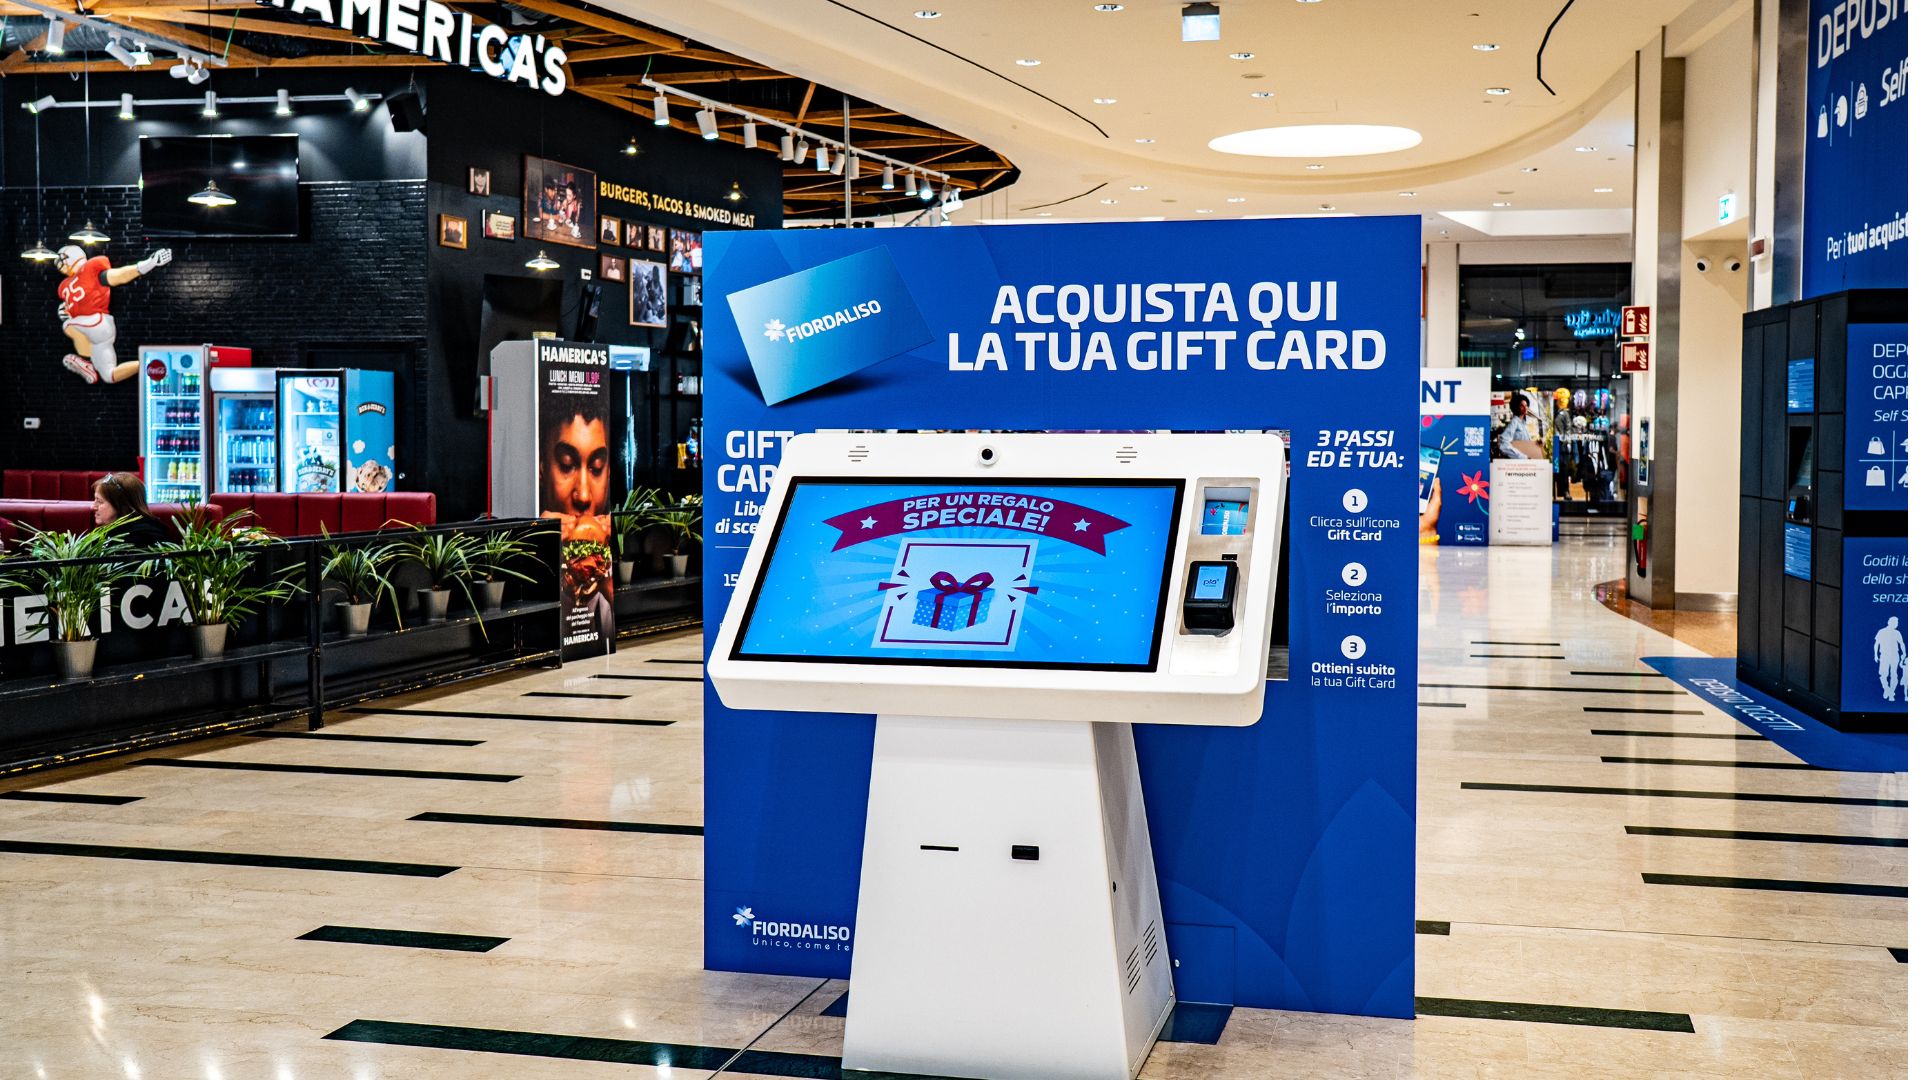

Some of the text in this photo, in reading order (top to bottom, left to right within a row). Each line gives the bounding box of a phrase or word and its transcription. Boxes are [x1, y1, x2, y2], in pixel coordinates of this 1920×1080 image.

[255, 0, 567, 96] MERICA'S
[600, 181, 755, 228] BURGERS, TACOS & SMOKED MEAT
[1827, 236, 1842, 261] Per
[1843, 232, 1846, 256] i
[1847, 222, 1868, 255] tuoi
[990, 281, 1337, 329] ACQUISTA QUI
[785, 299, 882, 344] FIORDALISO
[541, 345, 607, 366] HAMERICA'S
[948, 329, 1387, 371] LA TUA GIFT CARD
[1873, 343, 1908, 358] DEP
[549, 369, 568, 383] LUNCH
[568, 370, 585, 383] MENU
[1873, 364, 1908, 379] OGG
[1873, 385, 1908, 400] CAP
[1873, 409, 1899, 421] Self
[726, 430, 794, 459] GIFT
[1317, 430, 1395, 447] 3 PASSI
[1307, 447, 1405, 468] ED È TUA:
[904, 494, 1055, 513] PER UN REGALO
[1351, 495, 1359, 507] 1
[715, 518, 730, 534] di
[902, 507, 1051, 532] SPECIALE!
[1310, 516, 1342, 527] Clicca
[1327, 529, 1382, 541] Gift Card
[1863, 555, 1899, 566] Goditi
[1350, 569, 1359, 580] 2
[1862, 573, 1893, 584] dello
[1325, 589, 1382, 602] Seleziona
[1872, 593, 1908, 603] senza
[563, 631, 599, 646] HAMERICA'S
[1349, 642, 1358, 653] 3
[1311, 662, 1395, 675] Ottieni subito
[1311, 676, 1395, 689] la tua Gift Card
[752, 920, 850, 941] FIORDALISO
[752, 937, 793, 949] Unico,
[796, 942, 831, 950] come
